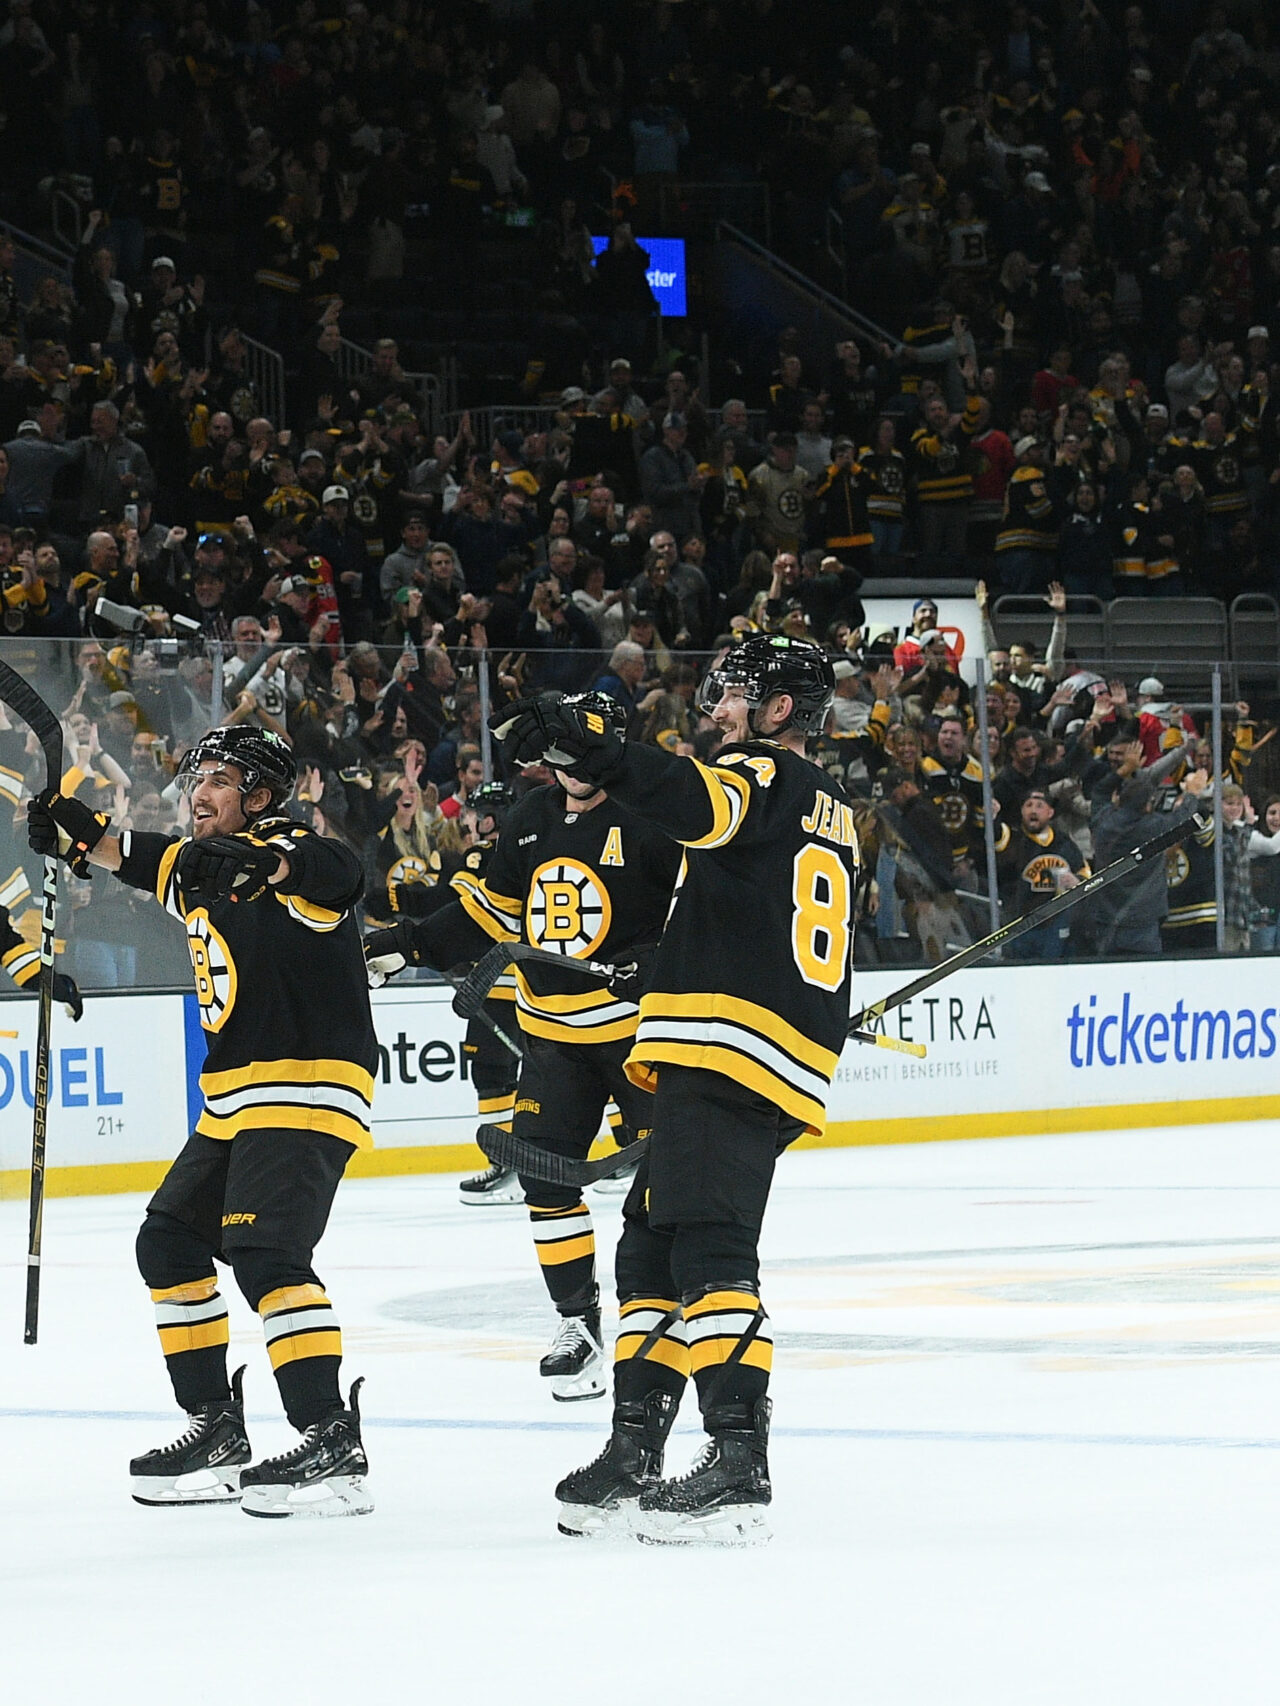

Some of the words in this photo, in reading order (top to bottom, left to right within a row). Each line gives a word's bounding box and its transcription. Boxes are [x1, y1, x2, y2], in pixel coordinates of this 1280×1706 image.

[599, 827, 624, 867] A
[801, 789, 860, 867] JEAN
[40, 856, 58, 967] CCM
[542, 882, 581, 940] B
[1067, 992, 1276, 1068] ticketmas
[902, 1062, 963, 1080] BENEFITS
[974, 1060, 999, 1077] LIFE
[31, 1064, 48, 1181] JETSPEED
[97, 1115, 125, 1137] 21+
[207, 1433, 239, 1462] CCM
